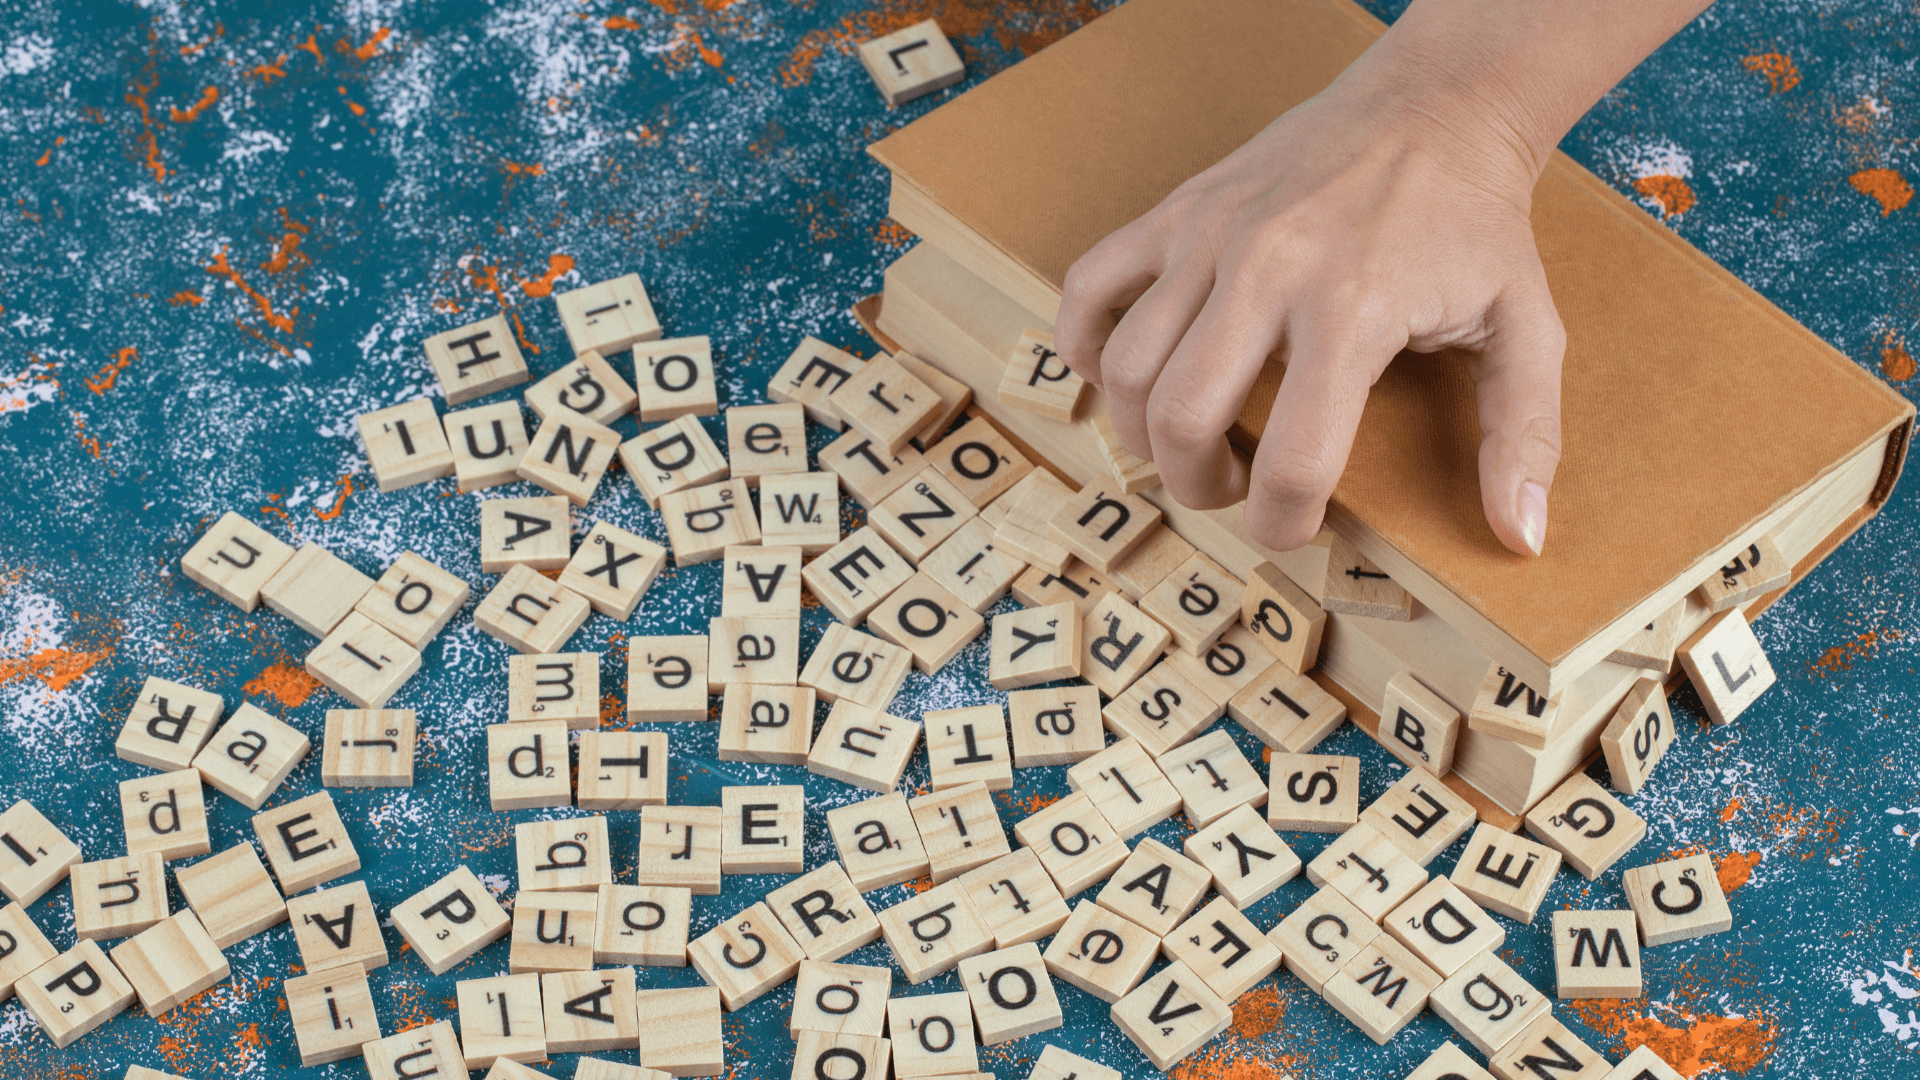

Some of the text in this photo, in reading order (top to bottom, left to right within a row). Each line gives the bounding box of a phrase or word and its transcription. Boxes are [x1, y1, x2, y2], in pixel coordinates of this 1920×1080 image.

[888, 38, 929, 71] L
[447, 330, 501, 371] H
[558, 374, 606, 414] G
[797, 355, 853, 396] E
[869, 382, 899, 414] r
[464, 420, 503, 460] U
[544, 425, 596, 477] N
[645, 432, 695, 471] D
[744, 423, 782, 454] e
[844, 438, 889, 475] T
[951, 441, 999, 481] O
[505, 511, 551, 545] A
[897, 491, 956, 539] Z
[584, 541, 643, 589] X
[829, 545, 886, 591] E
[957, 545, 993, 576] i
[744, 564, 786, 602] A
[1180, 582, 1219, 616] e
[898, 598, 946, 638] O
[737, 635, 775, 661] a
[1010, 627, 1055, 662] Y
[1090, 616, 1143, 671] R
[1205, 643, 1246, 676] e
[537, 663, 573, 702] m
[654, 656, 692, 689] e
[833, 652, 873, 683] e
[1711, 650, 1750, 694] L
[146, 698, 195, 743] R
[750, 701, 789, 728] a
[1036, 708, 1075, 735] a
[1394, 706, 1426, 753] B
[227, 730, 268, 766] a
[341, 738, 398, 753] j
[509, 735, 543, 778] d
[601, 746, 648, 778] T
[954, 724, 993, 765] T
[1195, 759, 1228, 791] t
[742, 804, 779, 844] E
[1392, 790, 1449, 839] E
[1561, 799, 1614, 838] G
[277, 812, 330, 862] E
[671, 825, 692, 859] r
[855, 821, 892, 854] a
[1226, 833, 1276, 877] Y
[1122, 863, 1172, 909] A
[1348, 853, 1388, 893] f
[1475, 844, 1534, 889] E
[421, 889, 476, 924] P
[791, 889, 849, 938] R
[998, 880, 1030, 914] t
[310, 904, 354, 949] A
[1423, 898, 1478, 945] D
[1081, 929, 1123, 964] e
[1210, 920, 1251, 969] F
[45, 961, 101, 996] P
[1463, 973, 1514, 1022] g
[325, 986, 343, 1030] i
[564, 984, 615, 1024] A
[1148, 980, 1202, 1024] V
[1521, 1036, 1584, 1080] N
